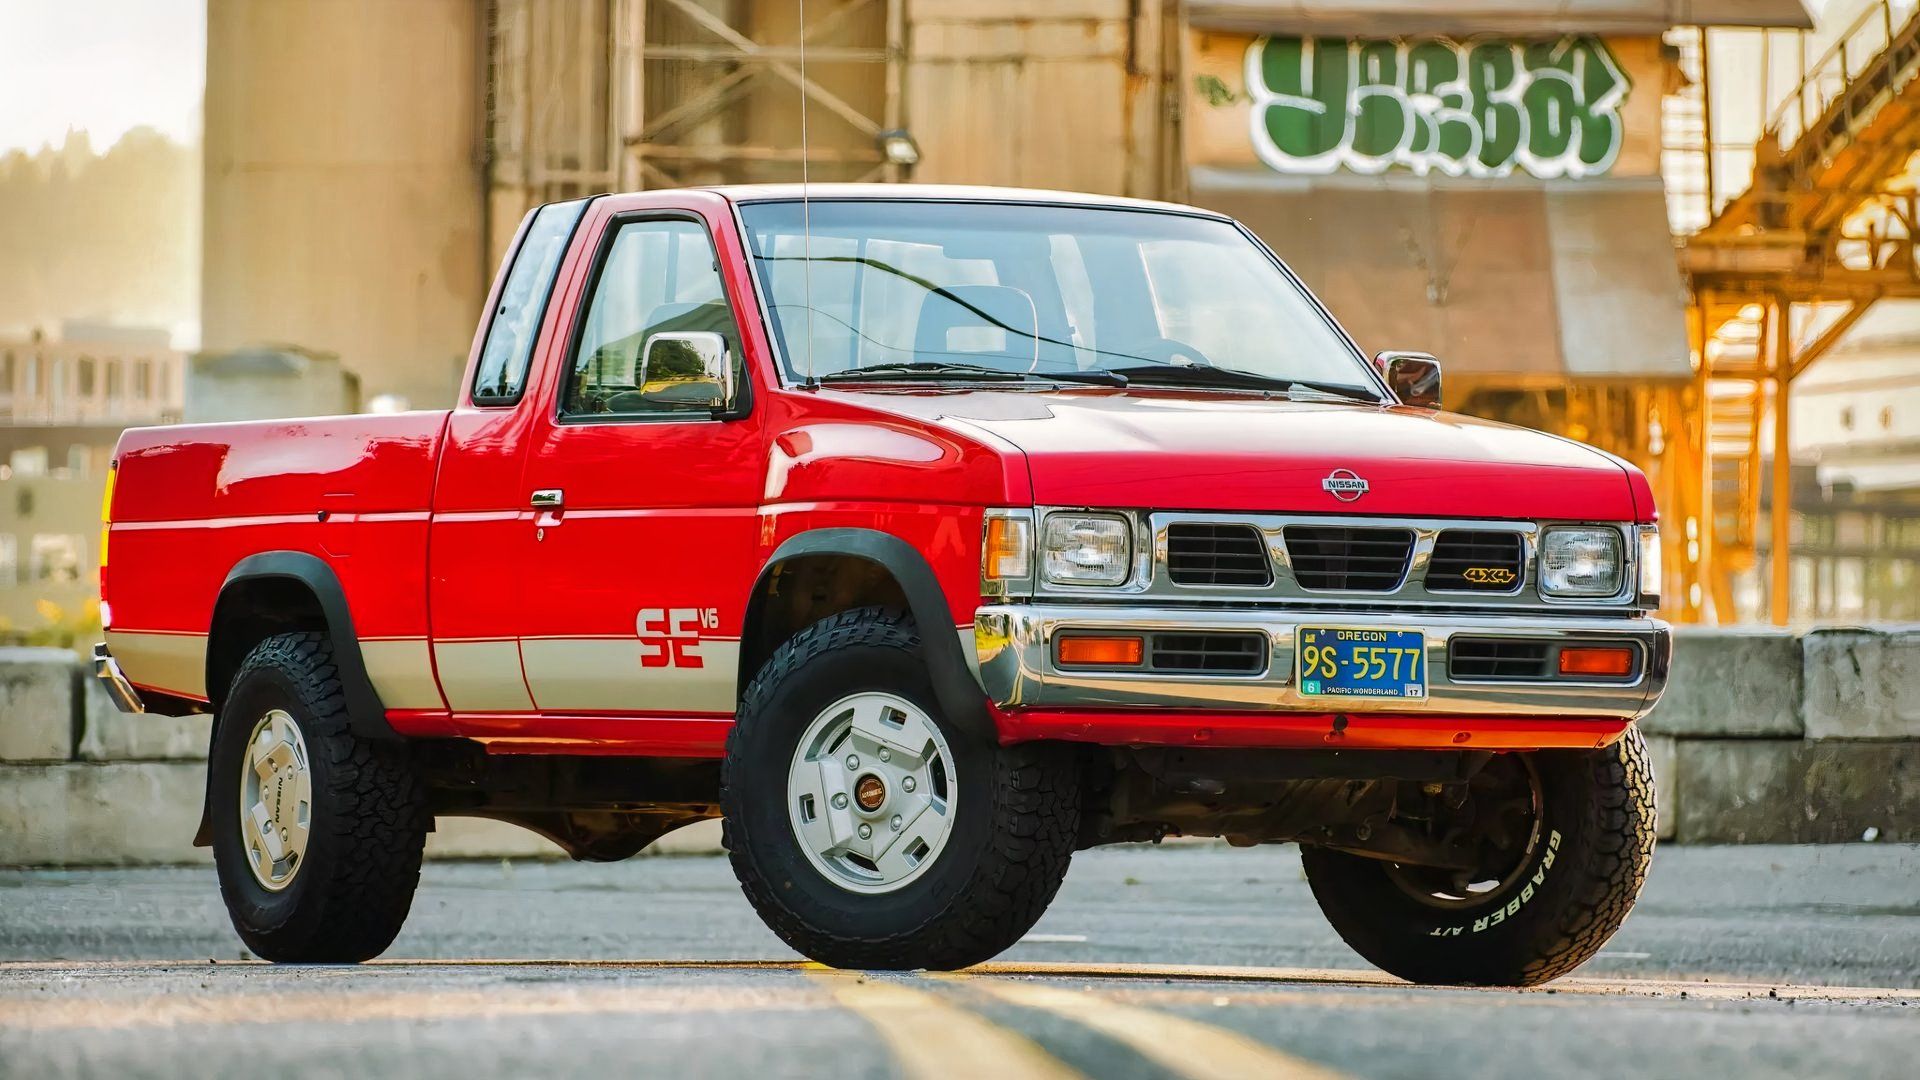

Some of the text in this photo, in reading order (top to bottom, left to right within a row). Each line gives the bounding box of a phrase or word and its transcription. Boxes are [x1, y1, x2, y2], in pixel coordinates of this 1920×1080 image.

[1328, 480, 1365, 489] NISSAN
[636, 607, 719, 668] SE V6
[1336, 631, 1387, 642] OREGON
[1303, 645, 1420, 681] 9S-5577
[1307, 682, 1315, 693] 6
[1327, 686, 1398, 696] PACIFIC WONDERLAND
[275, 777, 283, 823] NISSAN
[1429, 829, 1562, 937] GRABBER A/T
